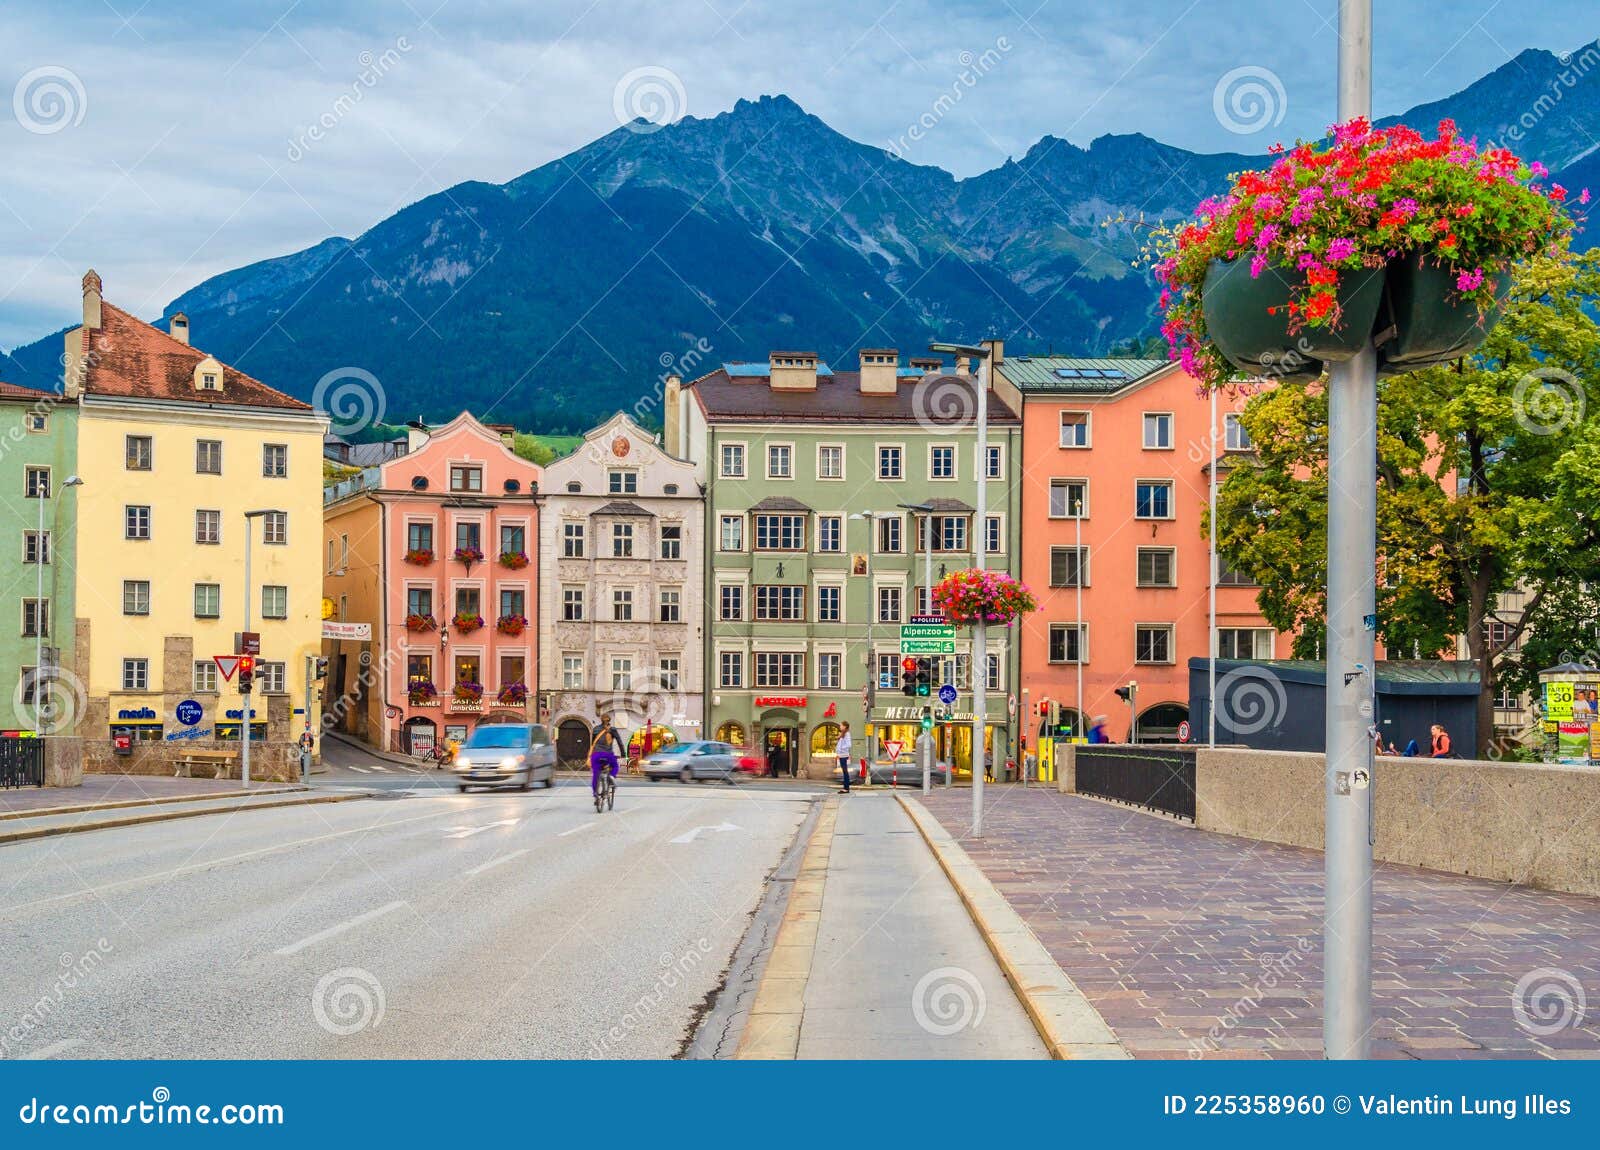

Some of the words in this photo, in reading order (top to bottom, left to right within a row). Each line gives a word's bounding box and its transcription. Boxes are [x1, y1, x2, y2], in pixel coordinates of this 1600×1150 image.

[903, 627, 942, 637] Alpenzoo
[452, 698, 482, 706] GASTOF
[755, 696, 807, 707] APOTHEKE
[1553, 693, 1572, 702] 30
